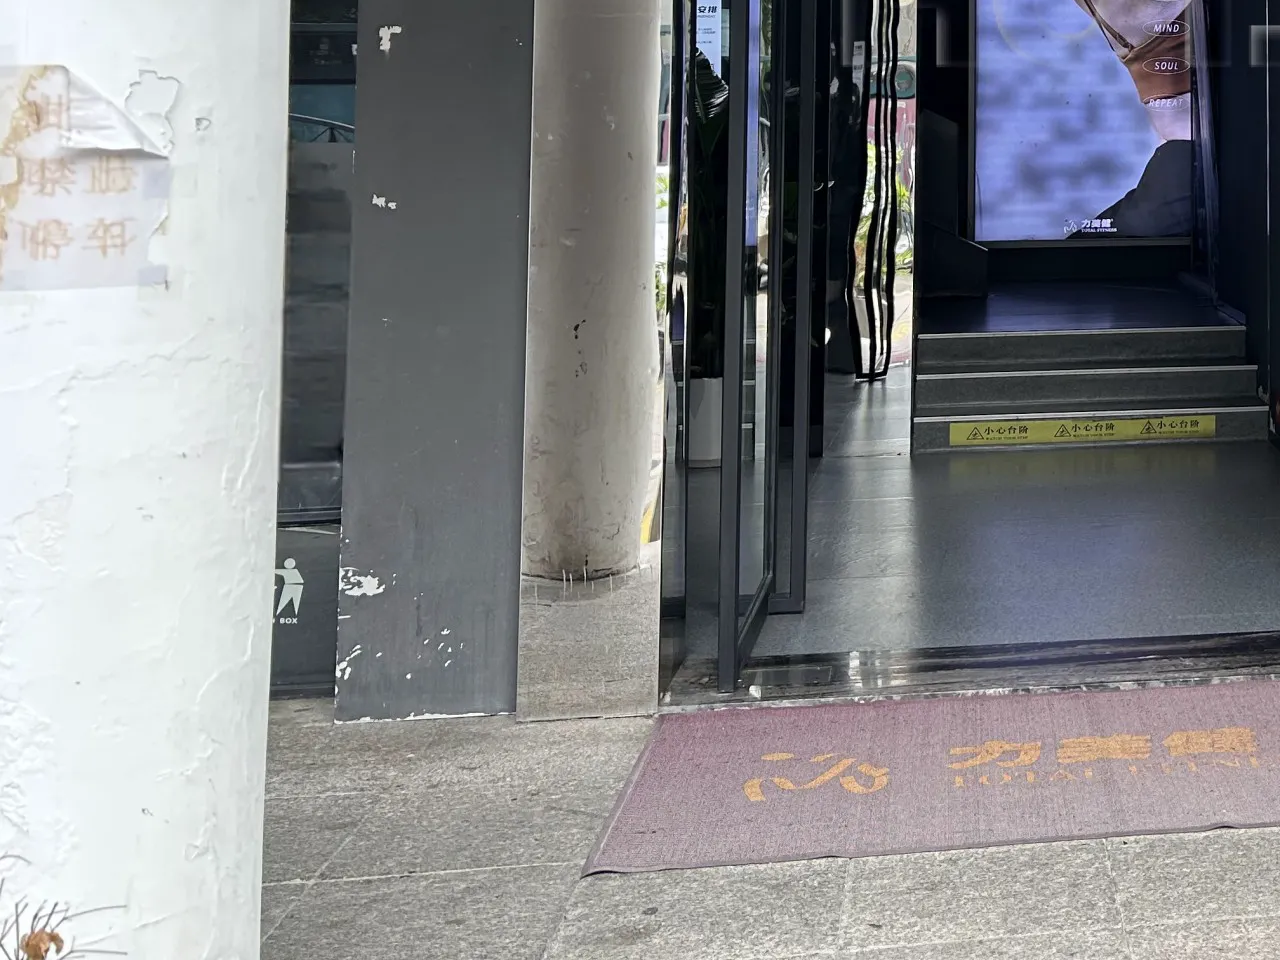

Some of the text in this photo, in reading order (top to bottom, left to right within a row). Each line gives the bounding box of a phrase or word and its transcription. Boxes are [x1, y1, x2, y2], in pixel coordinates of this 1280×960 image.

[1153, 23, 1180, 33] MIND
[1154, 60, 1179, 71] SOUL
[1149, 97, 1183, 108] REPEAT
[984, 425, 1029, 436] 小心台阶
[1071, 422, 1115, 433] 小心台阶
[1157, 420, 1200, 430] 小心台阶
[279, 617, 298, 625] BOX
